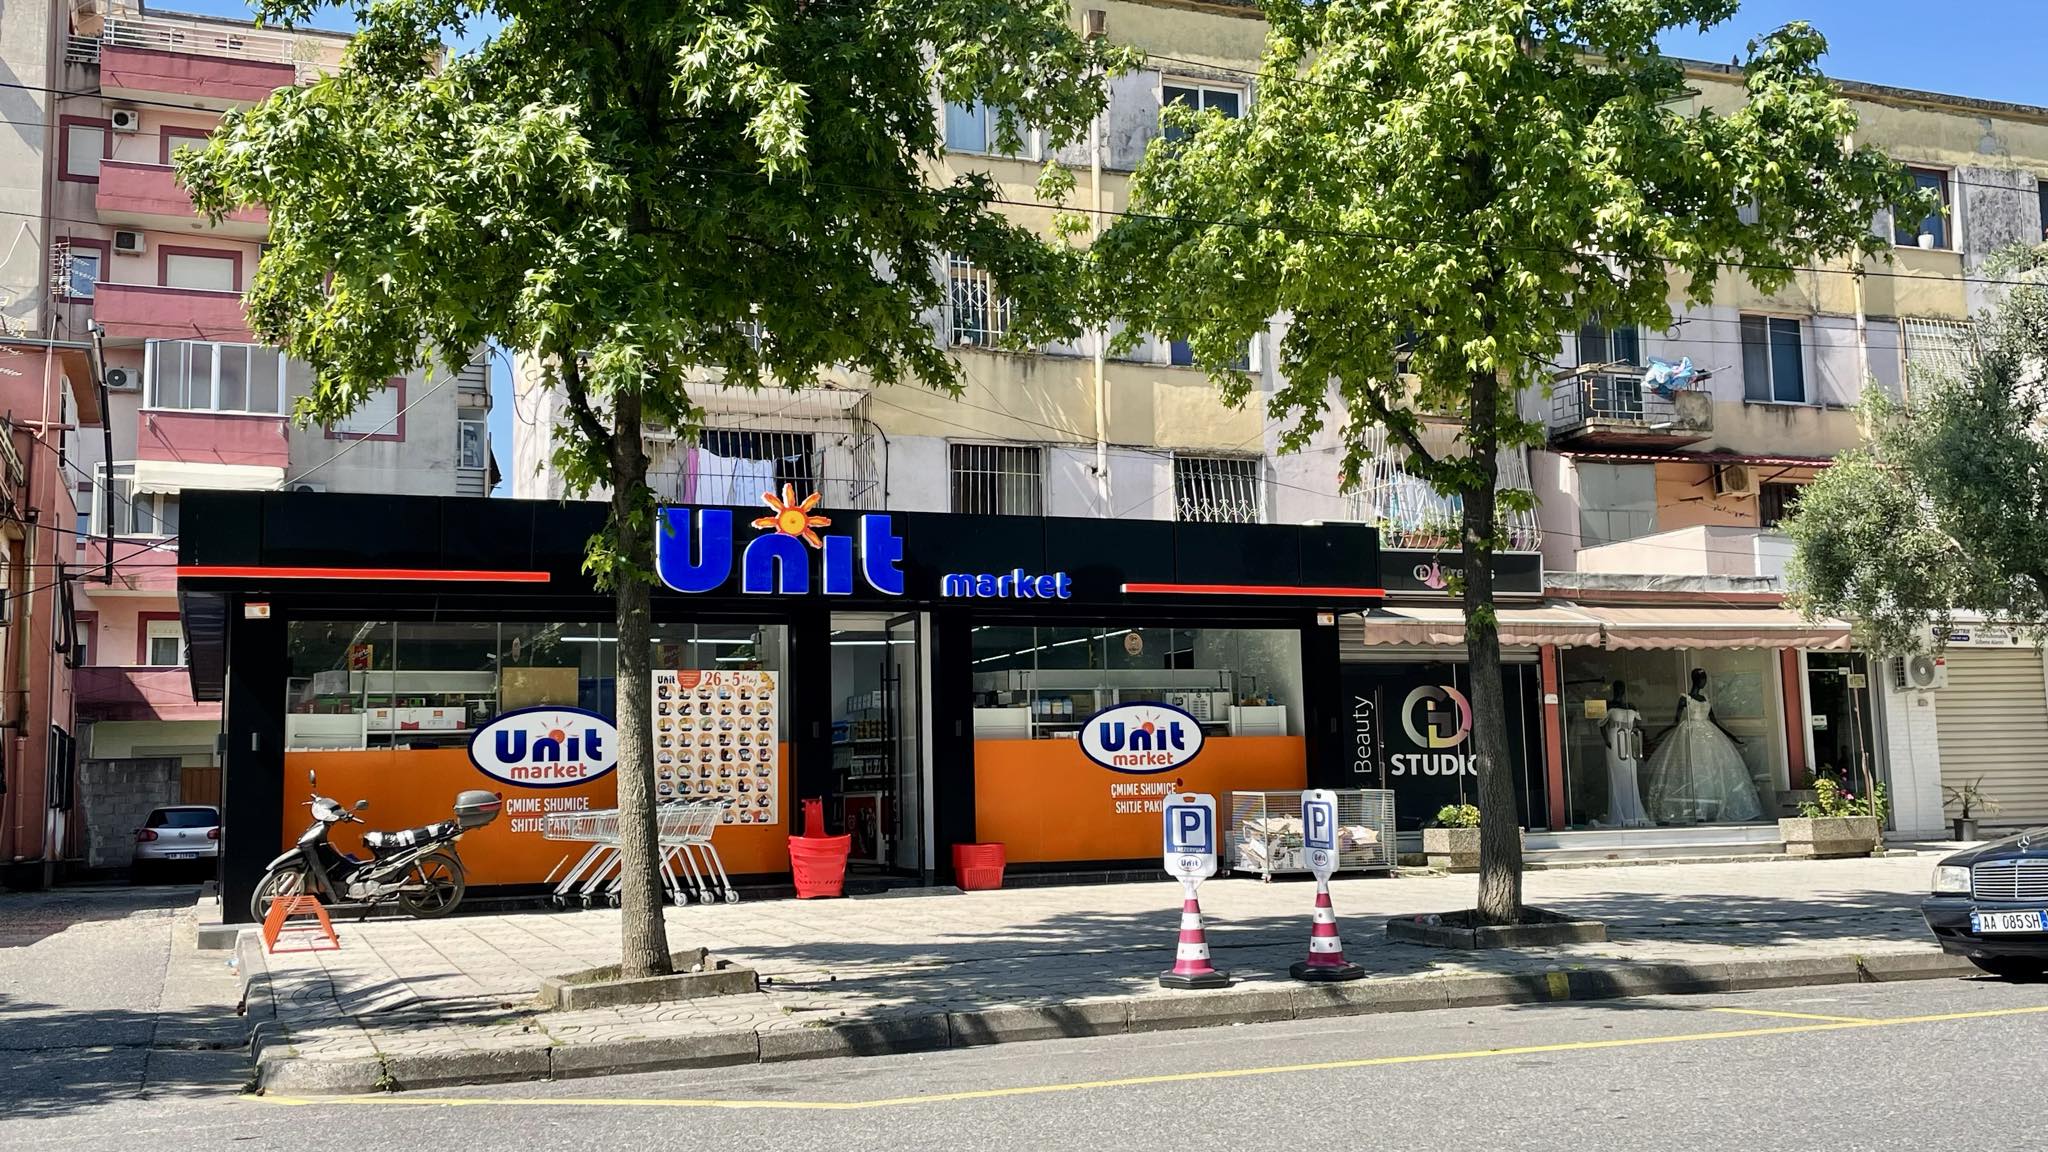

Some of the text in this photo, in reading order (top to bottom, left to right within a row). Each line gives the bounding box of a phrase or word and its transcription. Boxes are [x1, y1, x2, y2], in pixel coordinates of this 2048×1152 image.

[656, 508, 904, 596] Unit
[942, 569, 1072, 599] market
[657, 675, 675, 684] Unit
[705, 672, 720, 686] 26
[732, 672, 740, 686] 5
[1100, 721, 1185, 752] Unit
[1353, 696, 1373, 773] Beauty
[495, 729, 602, 763] Unit
[1113, 752, 1174, 766] market
[510, 763, 587, 779] market
[1111, 782, 1176, 798] ÇMIME SHUMICE
[506, 797, 589, 815] ÇMIME SHUMICE
[1116, 801, 1142, 814] SHITJE
[511, 818, 544, 832] SHITJE
[1180, 811, 1200, 843] P
[1312, 807, 1326, 838] P
[1181, 859, 1199, 867] Unit
